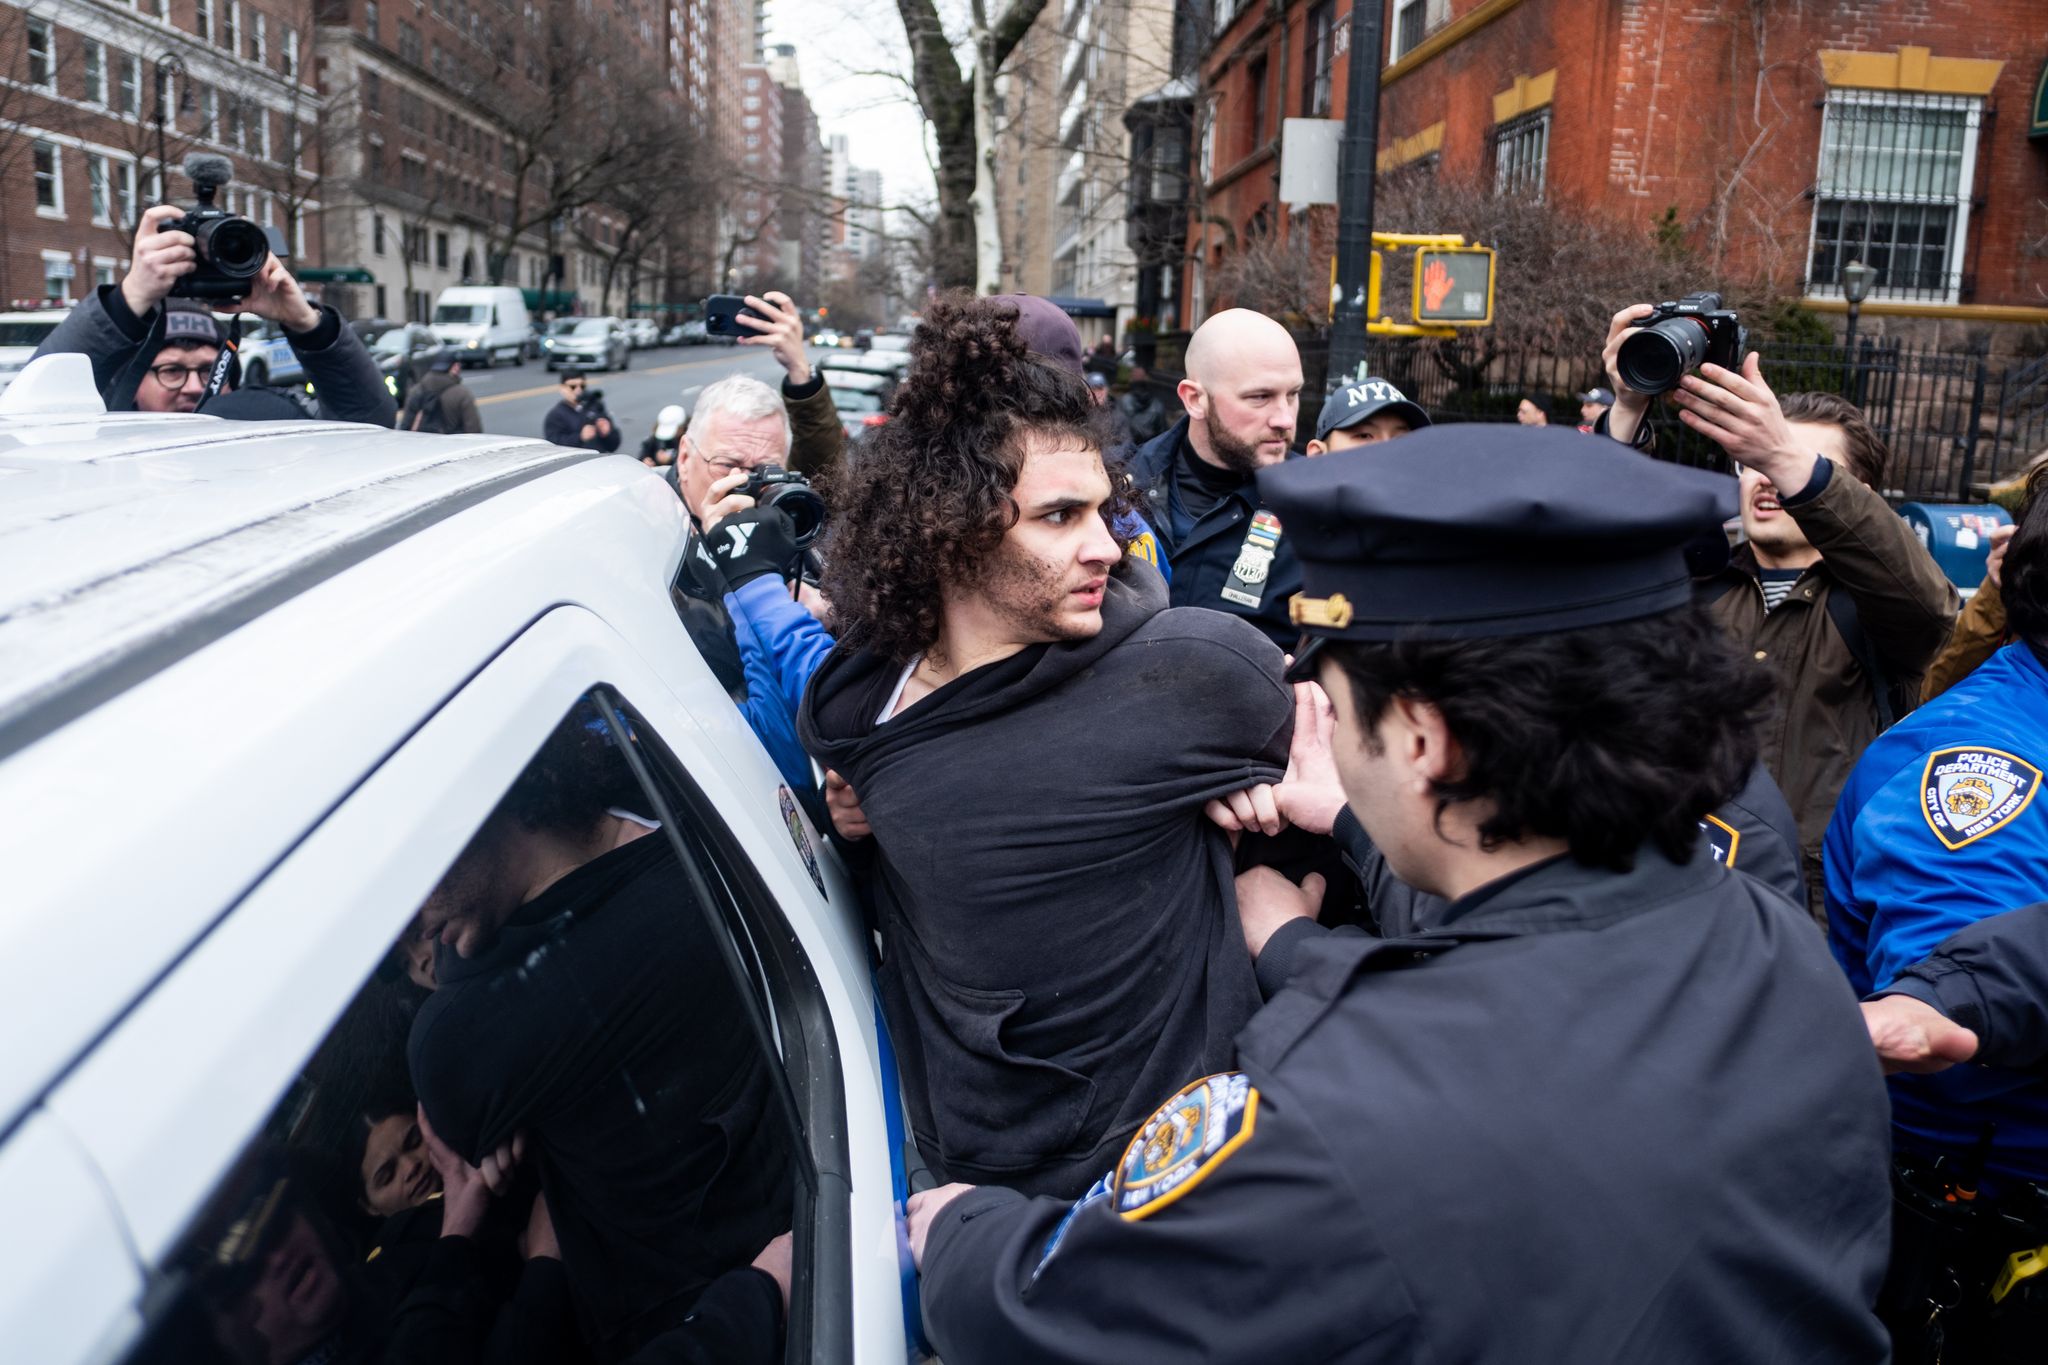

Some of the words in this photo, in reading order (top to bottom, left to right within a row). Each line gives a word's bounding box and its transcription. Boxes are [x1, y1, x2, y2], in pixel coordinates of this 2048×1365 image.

[170, 315, 210, 333] HH
[209, 348, 232, 395] SONY
[1957, 753, 2011, 770] POLICE
[1934, 762, 2027, 788] DEPARTMENT
[1926, 787, 1940, 812] CITY
[1932, 812, 1949, 828] OF
[1964, 816, 1995, 837] NEW
[1991, 793, 2024, 820] YORK
[1152, 1159, 1198, 1196] YORK
